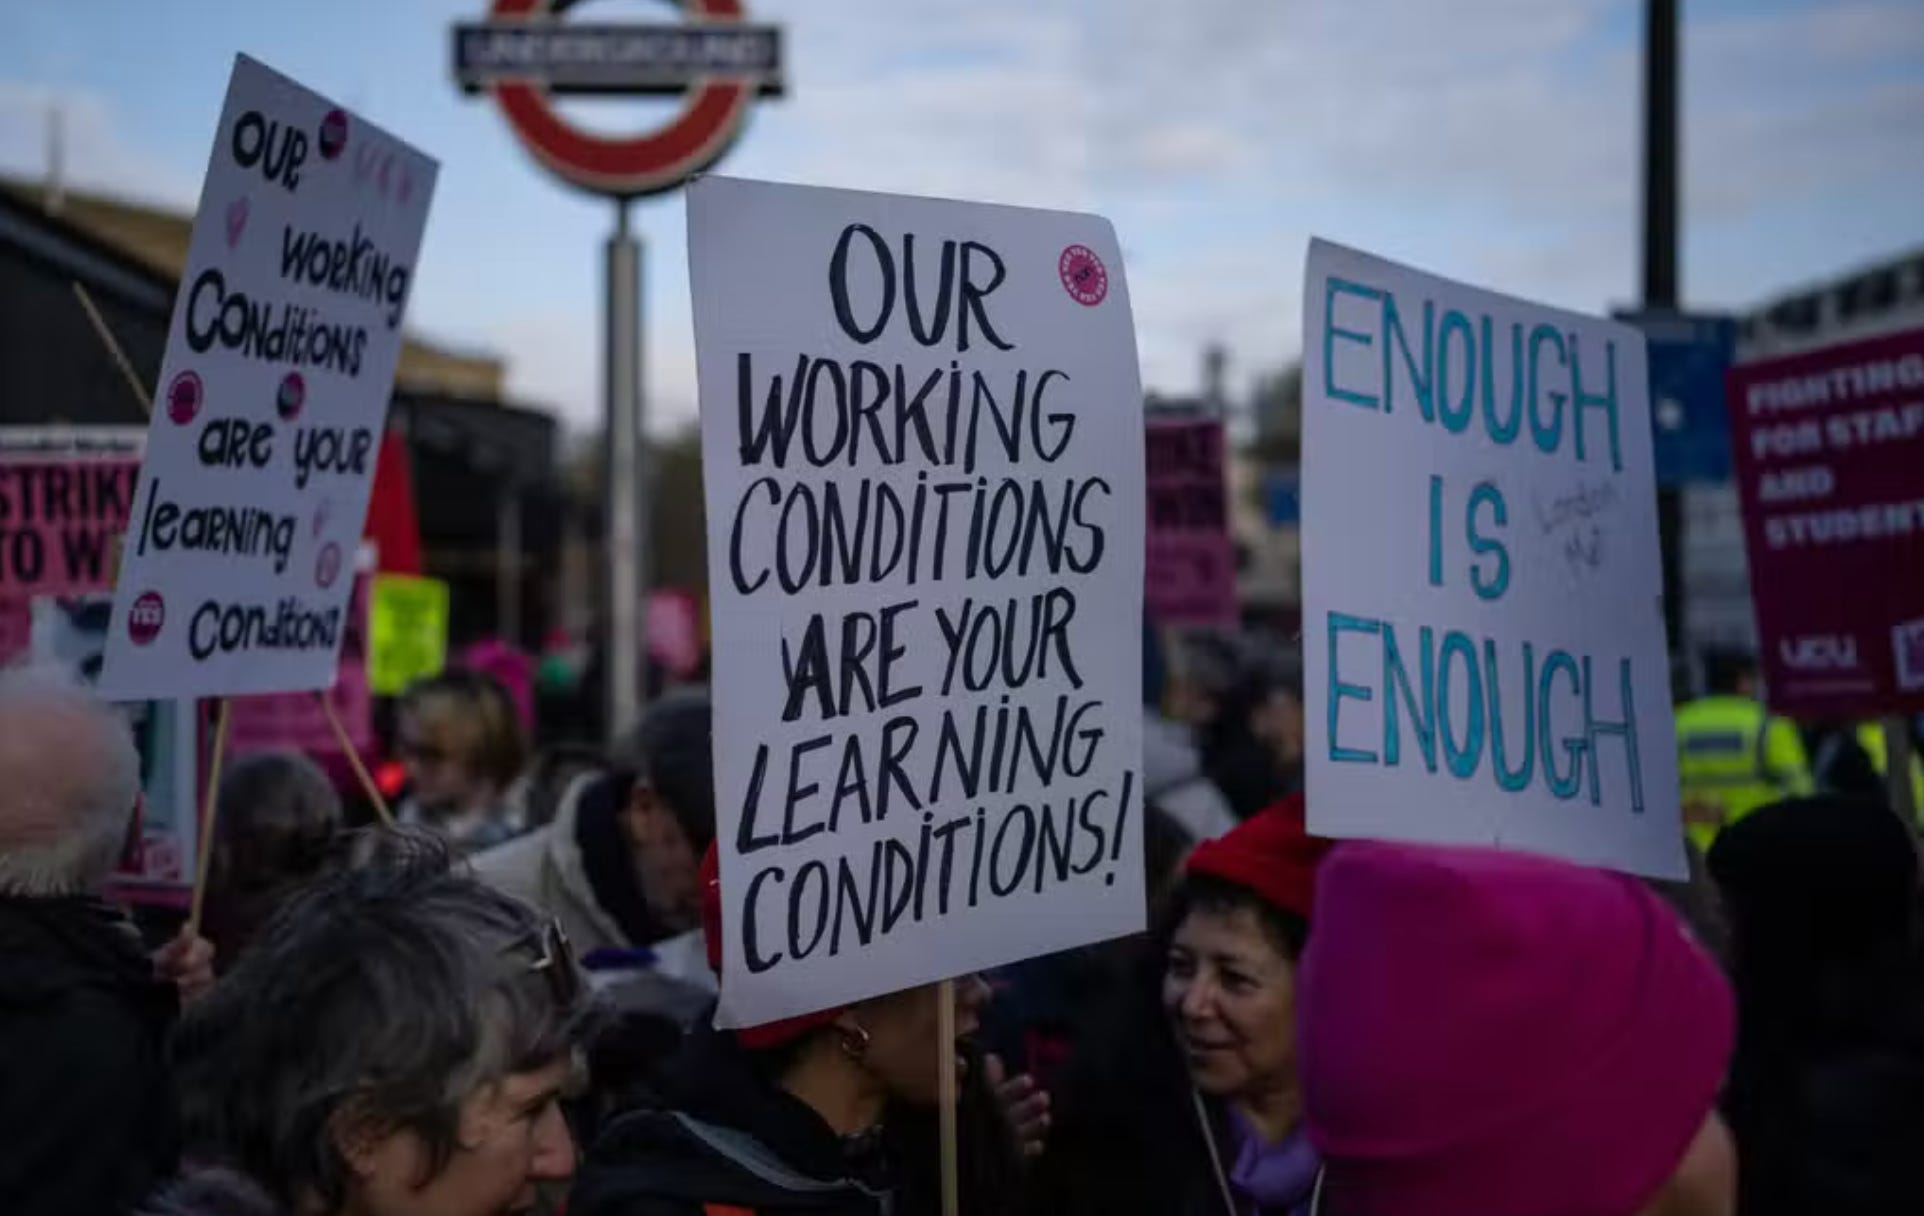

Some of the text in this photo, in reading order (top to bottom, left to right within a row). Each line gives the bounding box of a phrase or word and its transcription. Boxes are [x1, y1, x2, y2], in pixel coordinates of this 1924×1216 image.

[232, 110, 308, 192] OUR
[828, 223, 1016, 352] OUR
[1323, 276, 1623, 472] ENOUGH
[1750, 418, 1821, 461] FOR
[1759, 465, 1836, 503] AND
[1429, 475, 1510, 601] IS
[781, 586, 1084, 722] ARE YOUR
[1327, 610, 1645, 814] ENOUGH
[736, 694, 1105, 855] LEARNING
